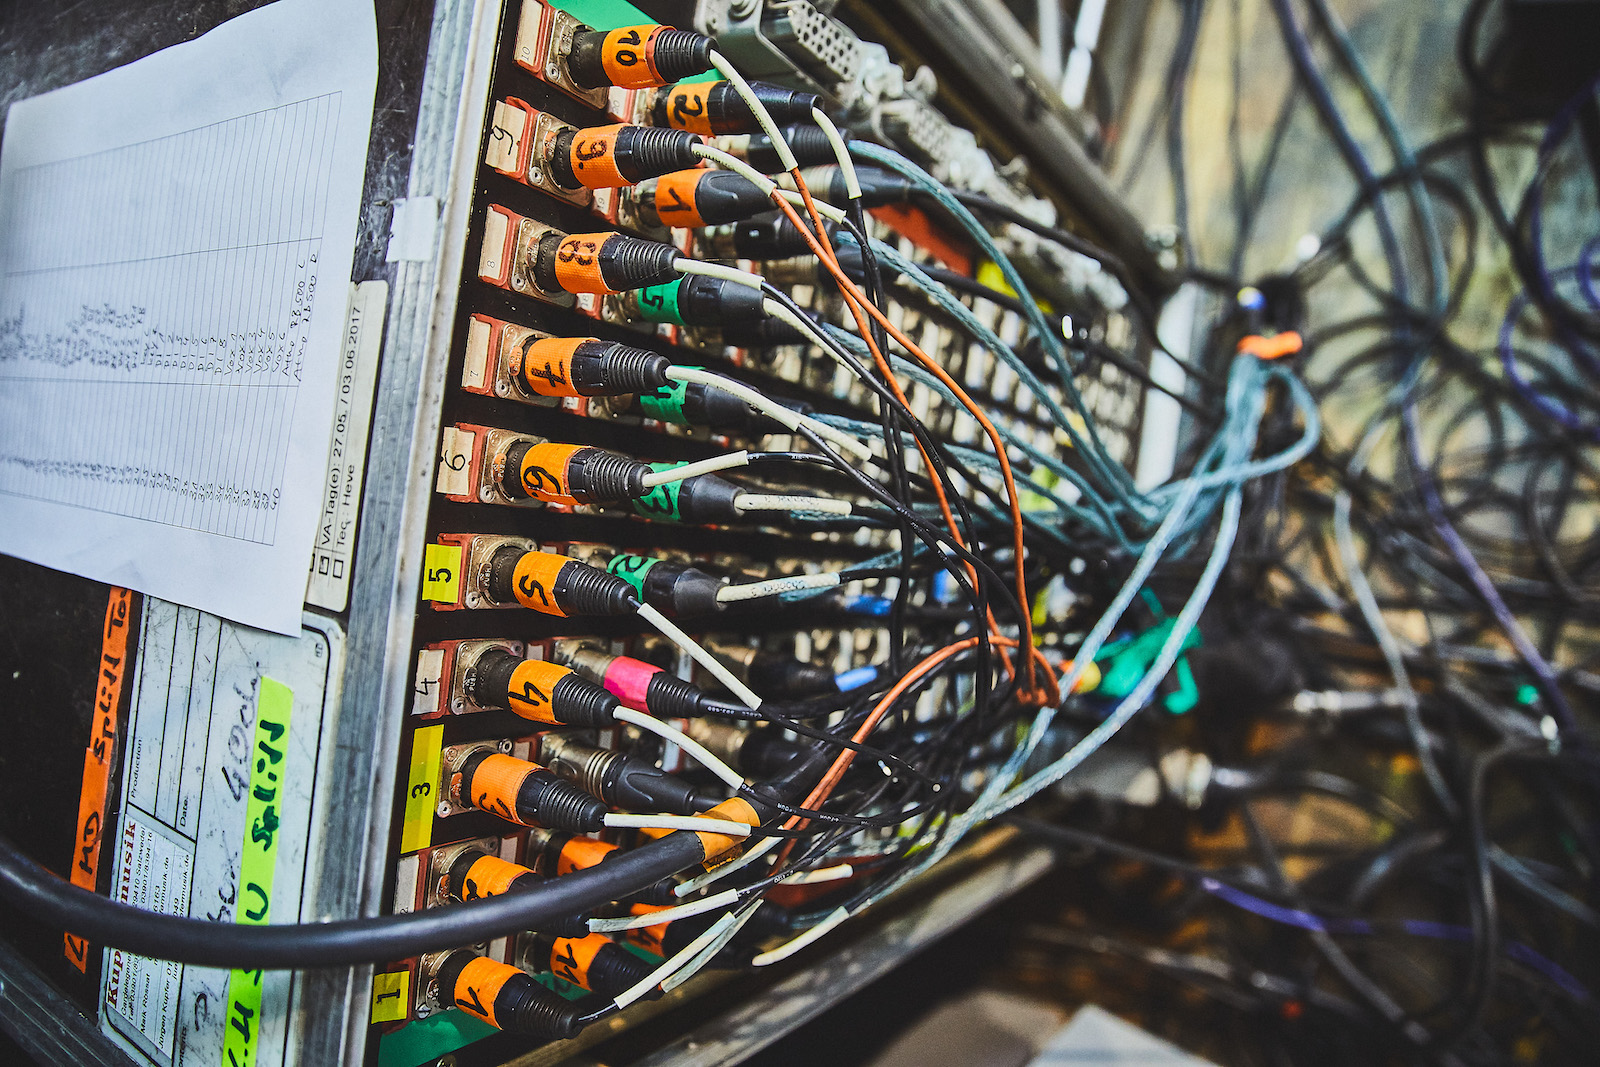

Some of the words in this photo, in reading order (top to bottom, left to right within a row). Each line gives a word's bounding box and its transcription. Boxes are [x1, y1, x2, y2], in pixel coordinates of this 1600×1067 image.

[521, 46, 531, 61] 10
[616, 30, 641, 66] 10
[674, 94, 703, 126] 2
[492, 125, 513, 155] 9
[658, 187, 692, 211] 1
[558, 240, 597, 266] 8
[531, 360, 566, 387] 7
[321, 463, 341, 545] VA-Tag(e):
[332, 410, 348, 458] 27.05.
[341, 306, 362, 394] 03.06.2017
[445, 450, 465, 471] 6
[342, 464, 355, 506] Heve
[270, 488, 280, 510] 40
[428, 568, 451, 583] 5
[519, 574, 549, 606] 5
[416, 678, 439, 695] 4
[507, 681, 549, 706] 4
[131, 736, 142, 798] Production:
[412, 782, 430, 799] 3
[136, 826, 146, 876] Salzwedel
[140, 831, 153, 904] 03901/8394-16
[161, 978, 170, 1012] Kupfer
[376, 989, 400, 1005] 1
[140, 1011, 148, 1034] Maik
[158, 1014, 166, 1049] Jürgen
